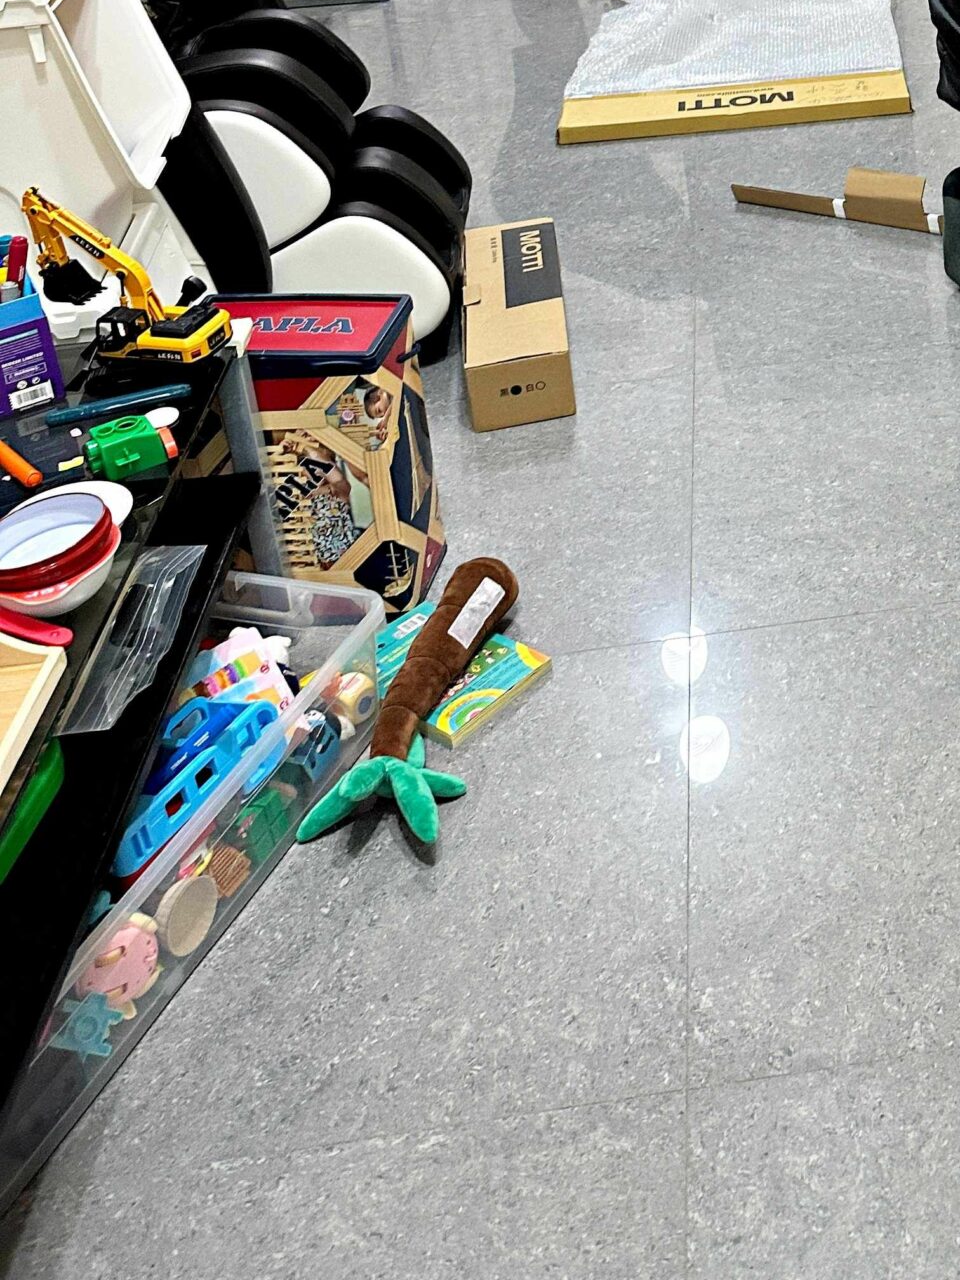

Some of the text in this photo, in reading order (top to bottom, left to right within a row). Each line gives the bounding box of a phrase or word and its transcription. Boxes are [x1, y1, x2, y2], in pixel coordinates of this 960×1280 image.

[677, 91, 794, 112] MOTTI
[520, 230, 544, 273] MOTTI
[252, 317, 355, 333] APLA
